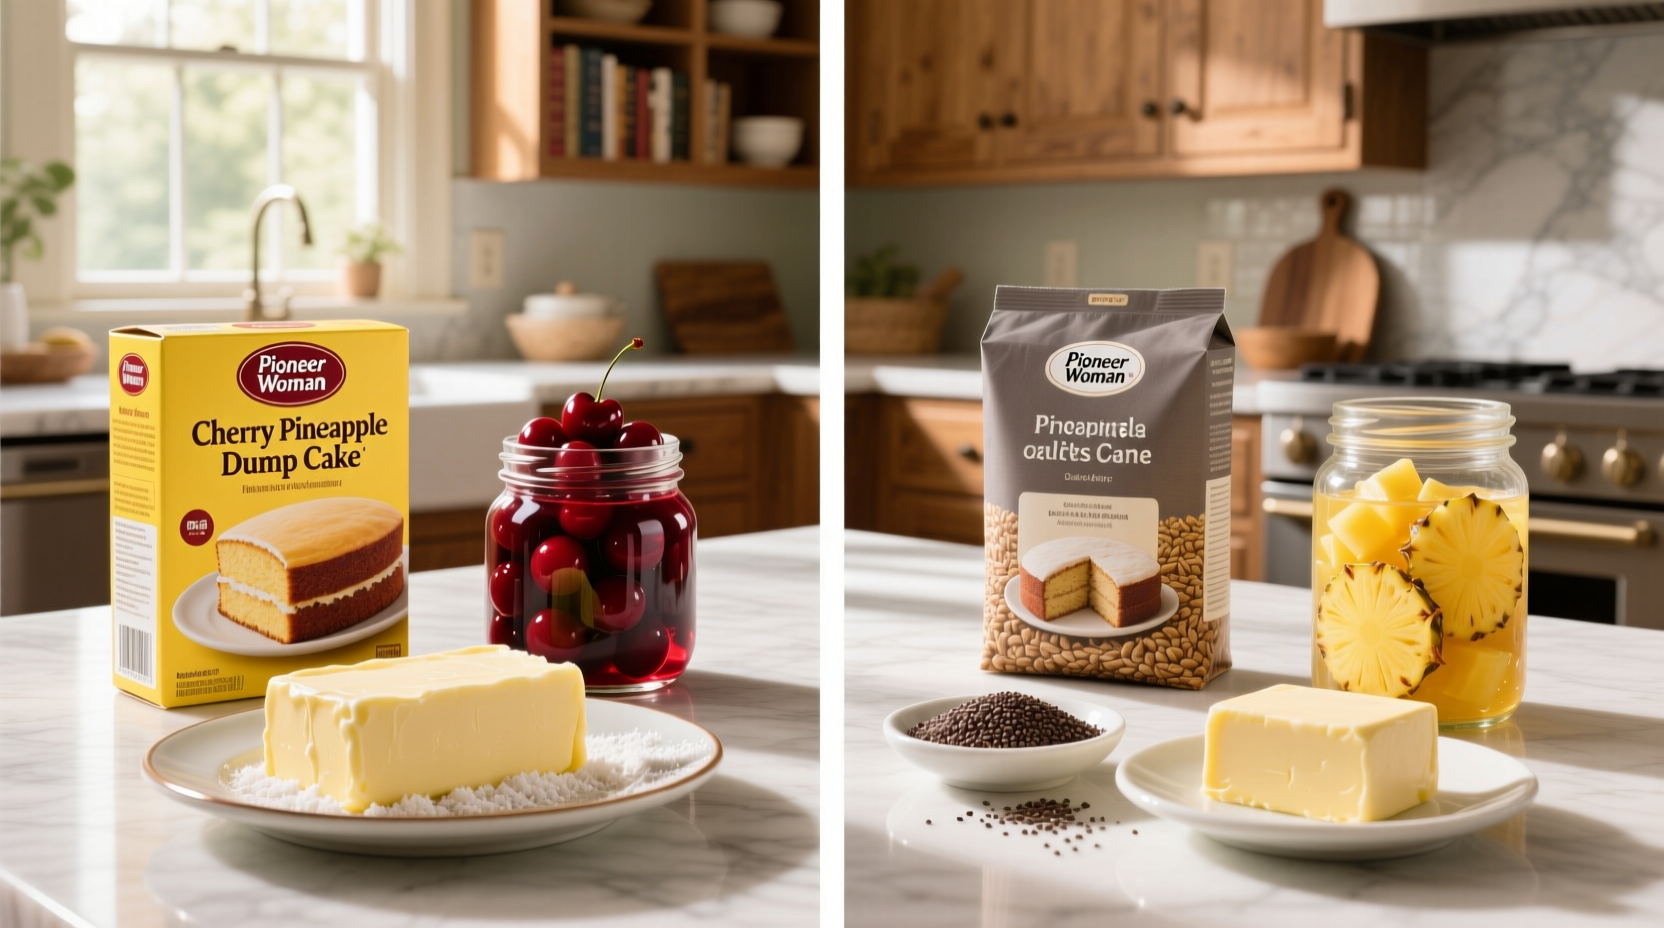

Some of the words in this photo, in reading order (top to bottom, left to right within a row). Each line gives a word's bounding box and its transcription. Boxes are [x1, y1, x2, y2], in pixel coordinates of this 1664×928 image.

[258, 354, 326, 374] Pioneer
[1065, 351, 1130, 369] Pioneer
[257, 374, 326, 393] Woman
[1065, 367, 1125, 384] Woman
[191, 418, 275, 450] Cherry
[279, 412, 388, 444] Pineapple
[221, 451, 298, 480] Dump
